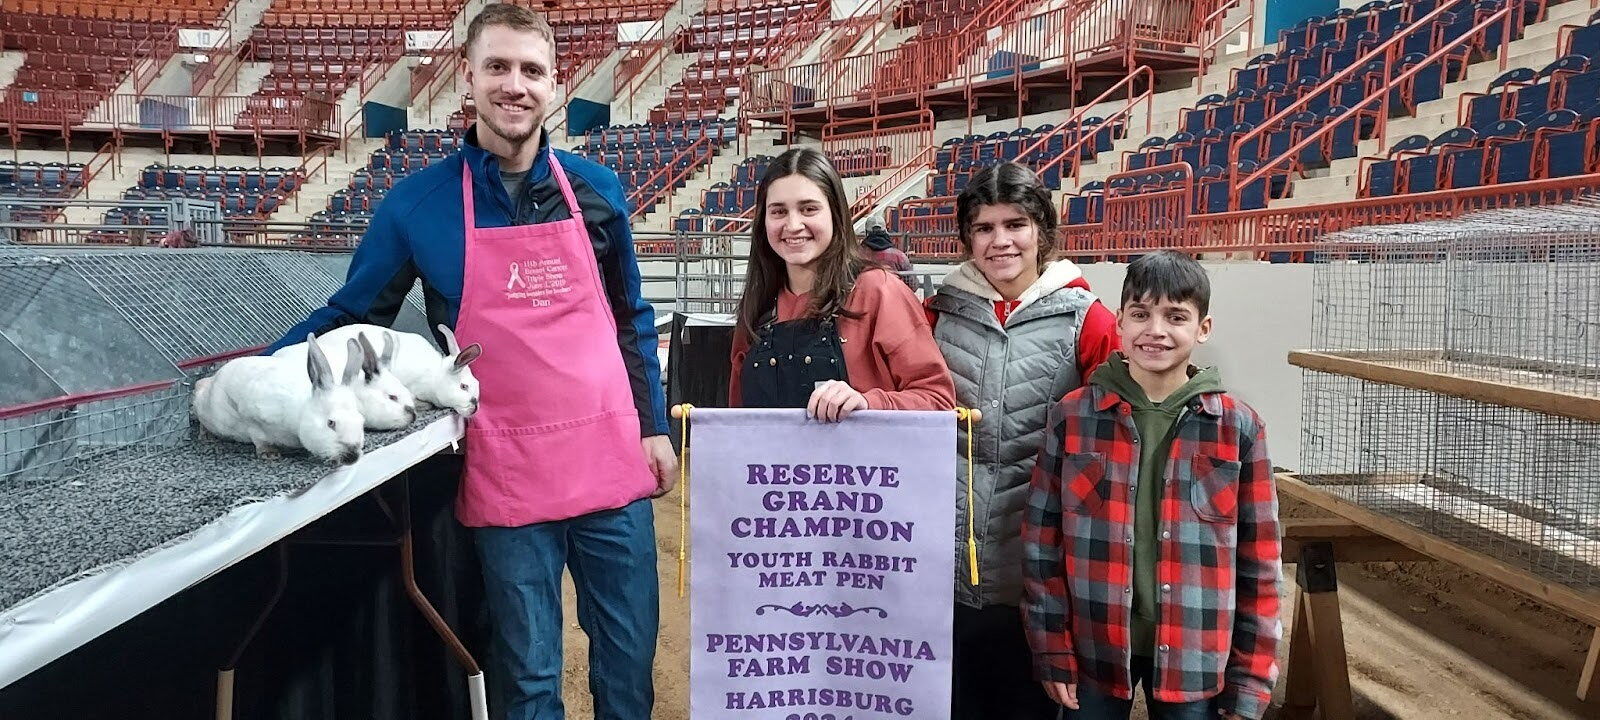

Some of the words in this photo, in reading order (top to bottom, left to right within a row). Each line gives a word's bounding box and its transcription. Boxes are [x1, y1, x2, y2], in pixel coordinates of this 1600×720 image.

[525, 267, 545, 275] Breast
[547, 265, 568, 273] Cancer
[538, 257, 561, 266] Annual
[526, 274, 544, 283] Triple
[527, 282, 543, 290] June
[532, 299, 551, 307] Dan
[746, 463, 900, 489] RESERVE
[762, 489, 884, 514] GRAND
[730, 516, 915, 543] CHAMPION
[726, 551, 813, 569] YOUTH
[821, 551, 918, 573] RABBIT
[758, 570, 828, 588] MEAT
[835, 570, 886, 591] PEN
[705, 631, 937, 661] PENNSYLVANIA
[727, 655, 811, 678] FARM
[825, 655, 915, 684] SHOW
[725, 687, 915, 717] HARRISBURG
